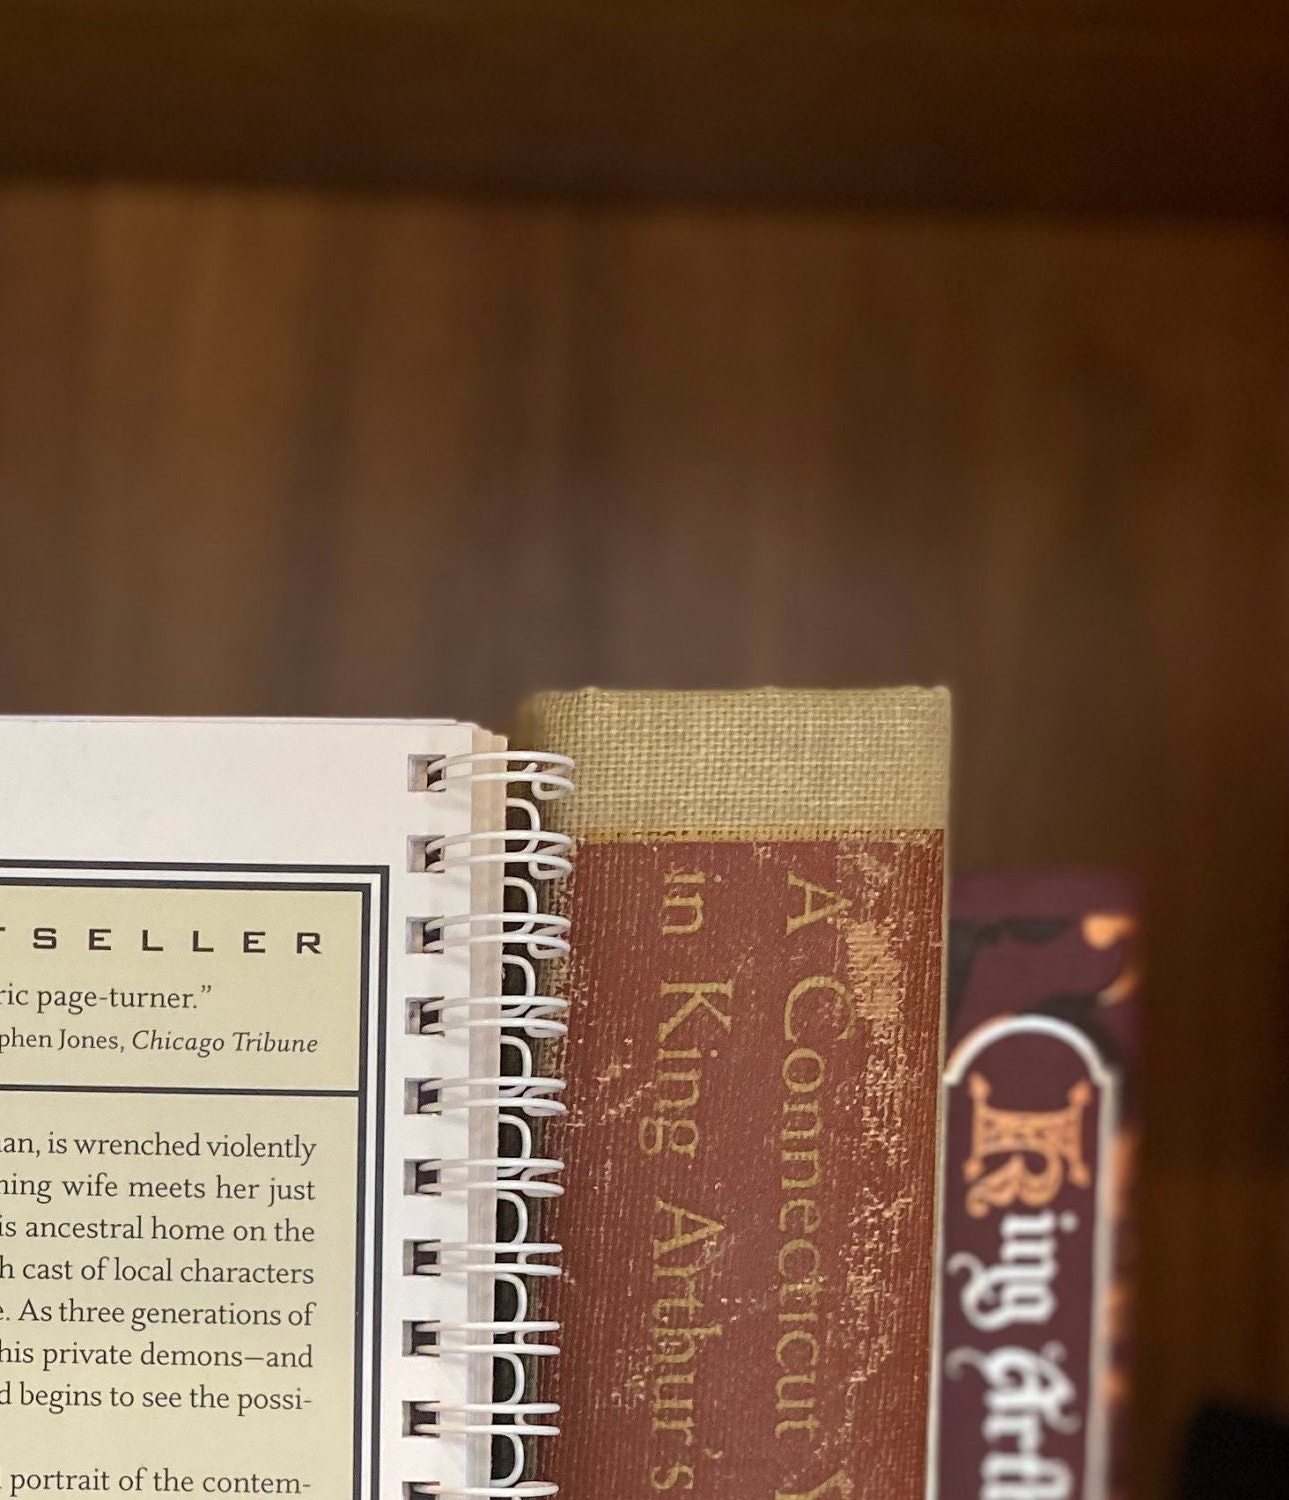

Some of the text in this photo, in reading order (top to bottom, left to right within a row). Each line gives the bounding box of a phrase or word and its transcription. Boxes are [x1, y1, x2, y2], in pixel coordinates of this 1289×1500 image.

[659, 868, 724, 938] in
[784, 870, 853, 938] A
[56, 1027, 126, 1054] Jones,
[131, 1028, 226, 1060] Chicago
[231, 1030, 319, 1054] Tribune
[637, 978, 735, 1159] King
[46, 1129, 68, 1155] is
[72, 1130, 202, 1158] wrenched
[205, 1131, 318, 1168] violently
[773, 975, 856, 1441] Connecticut
[945, 1071, 1093, 1332] King
[21, 1259, 75, 1282] cast
[80, 1255, 111, 1282] of
[113, 1255, 174, 1283] local
[179, 1256, 316, 1285] characters
[648, 1197, 725, 1493] Arthur's
